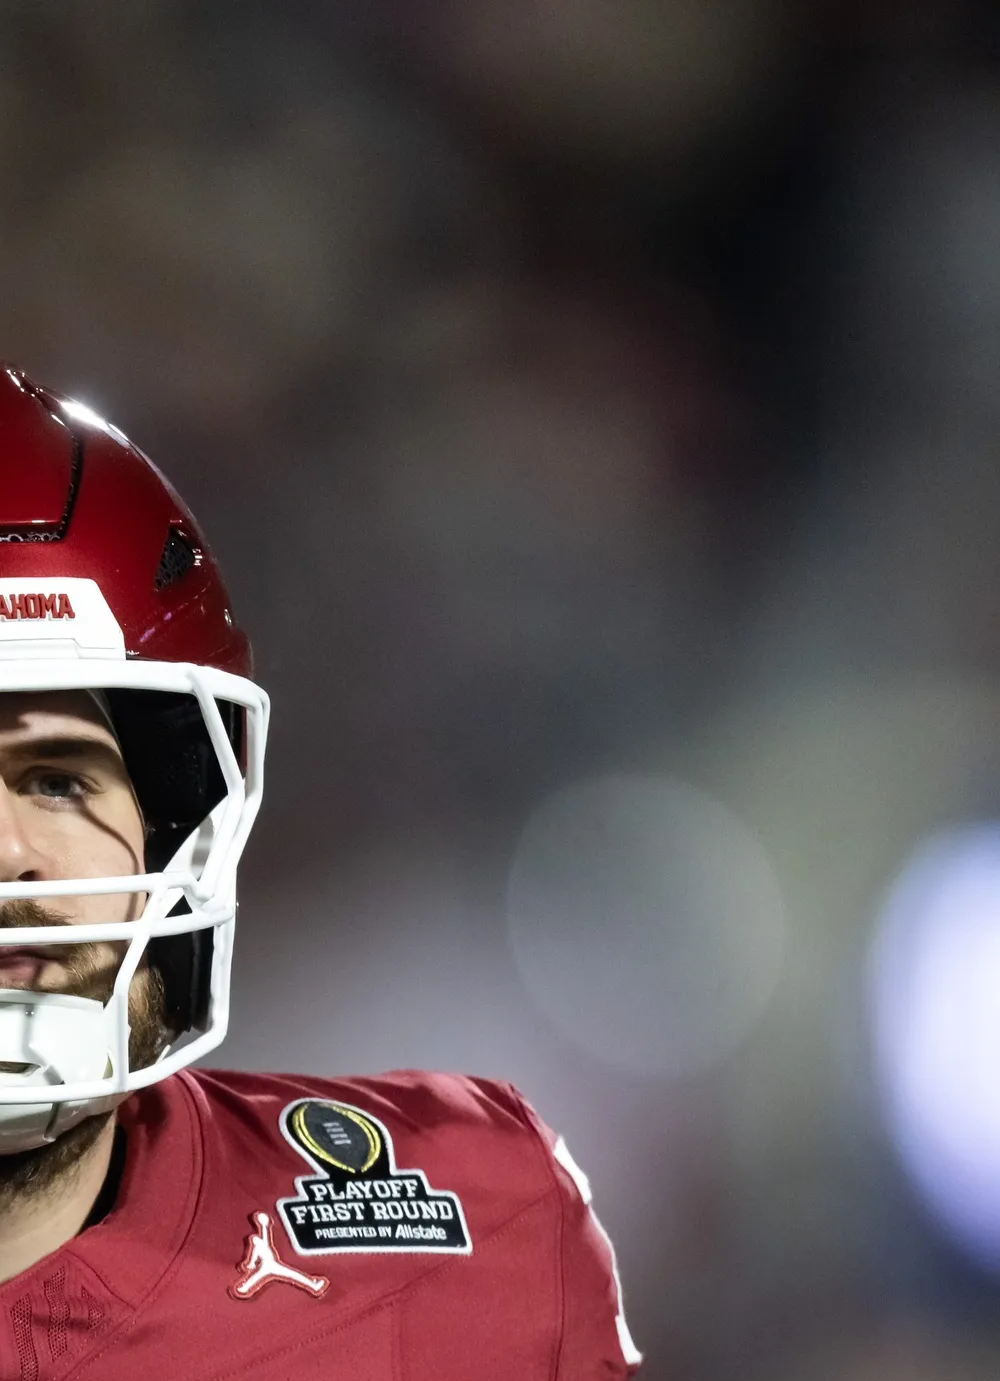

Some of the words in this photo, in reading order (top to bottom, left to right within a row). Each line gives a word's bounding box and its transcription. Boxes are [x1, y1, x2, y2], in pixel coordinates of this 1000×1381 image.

[309, 1178, 418, 1202] PLAYOFF
[290, 1202, 365, 1225] FIRST
[370, 1200, 454, 1221] ROUND
[315, 1226, 377, 1240] PRESENTED
[378, 1225, 392, 1238] BY
[395, 1223, 447, 1241] Allstate
